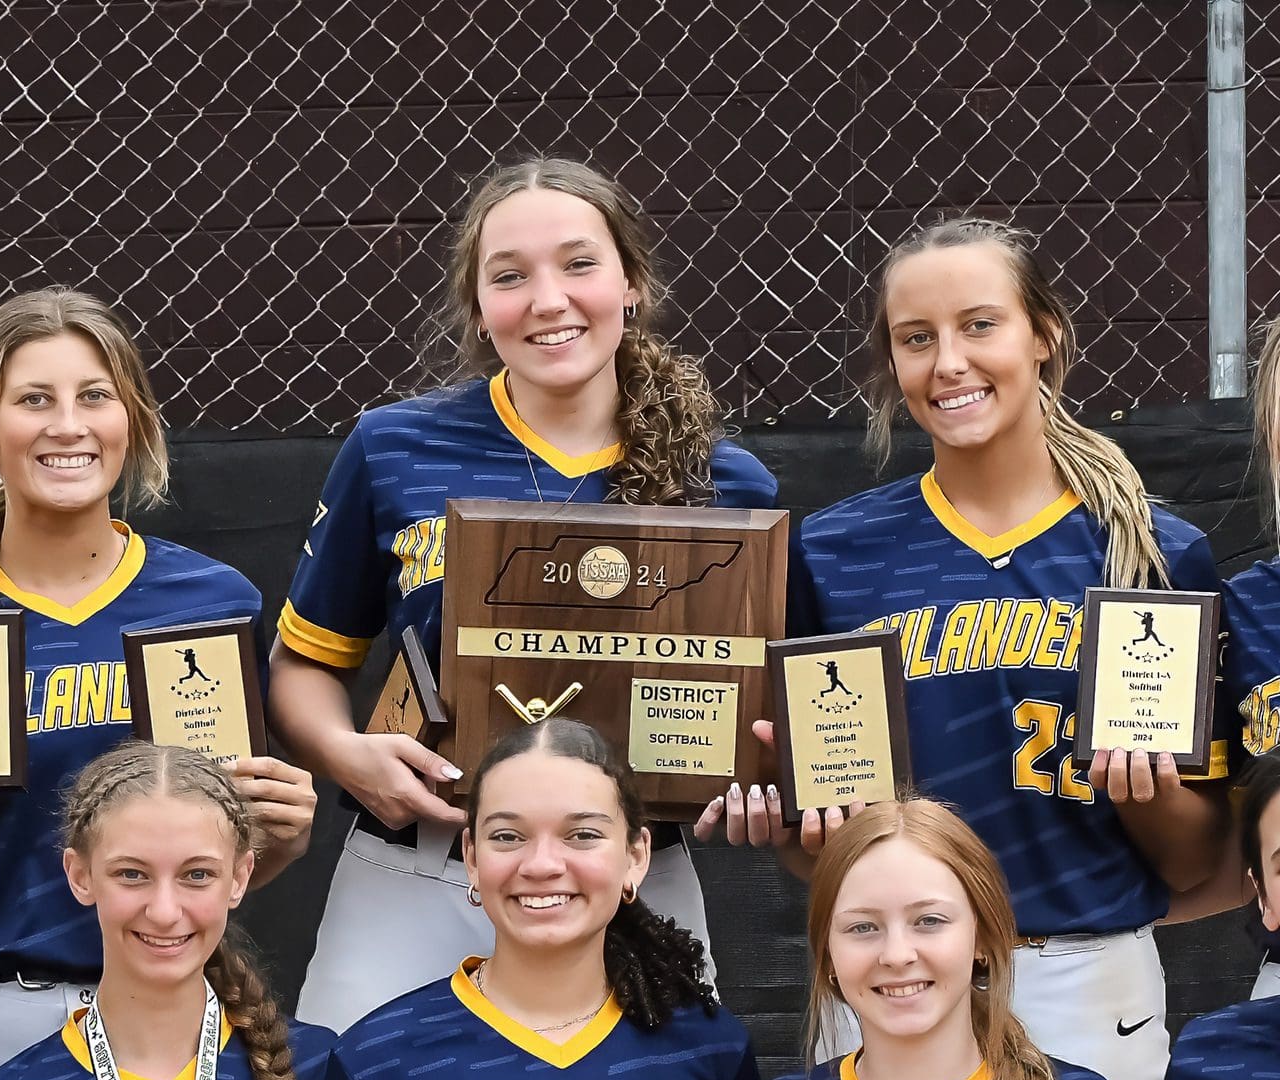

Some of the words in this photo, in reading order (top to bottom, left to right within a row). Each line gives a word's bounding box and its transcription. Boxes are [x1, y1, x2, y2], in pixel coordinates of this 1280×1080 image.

[542, 561, 572, 584] 20
[636, 564, 667, 587] 24
[494, 631, 732, 660] CHAMPIONS
[1122, 670, 1154, 679] District
[1128, 682, 1163, 692] Softball
[640, 685, 727, 704] DISTRICT
[175, 707, 206, 719] District
[647, 706, 706, 721] DIVISION
[1134, 708, 1155, 717] ALL
[183, 718, 216, 730] Softball
[815, 722, 847, 733] District
[1107, 719, 1181, 731] TOURNAMENT
[648, 733, 713, 747] SOFTBALL
[823, 733, 857, 745] Softball
[656, 758, 687, 768] CLASS
[693, 760, 704, 769] 1A
[850, 758, 875, 768] Valley
[813, 772, 876, 785] All-Conference
